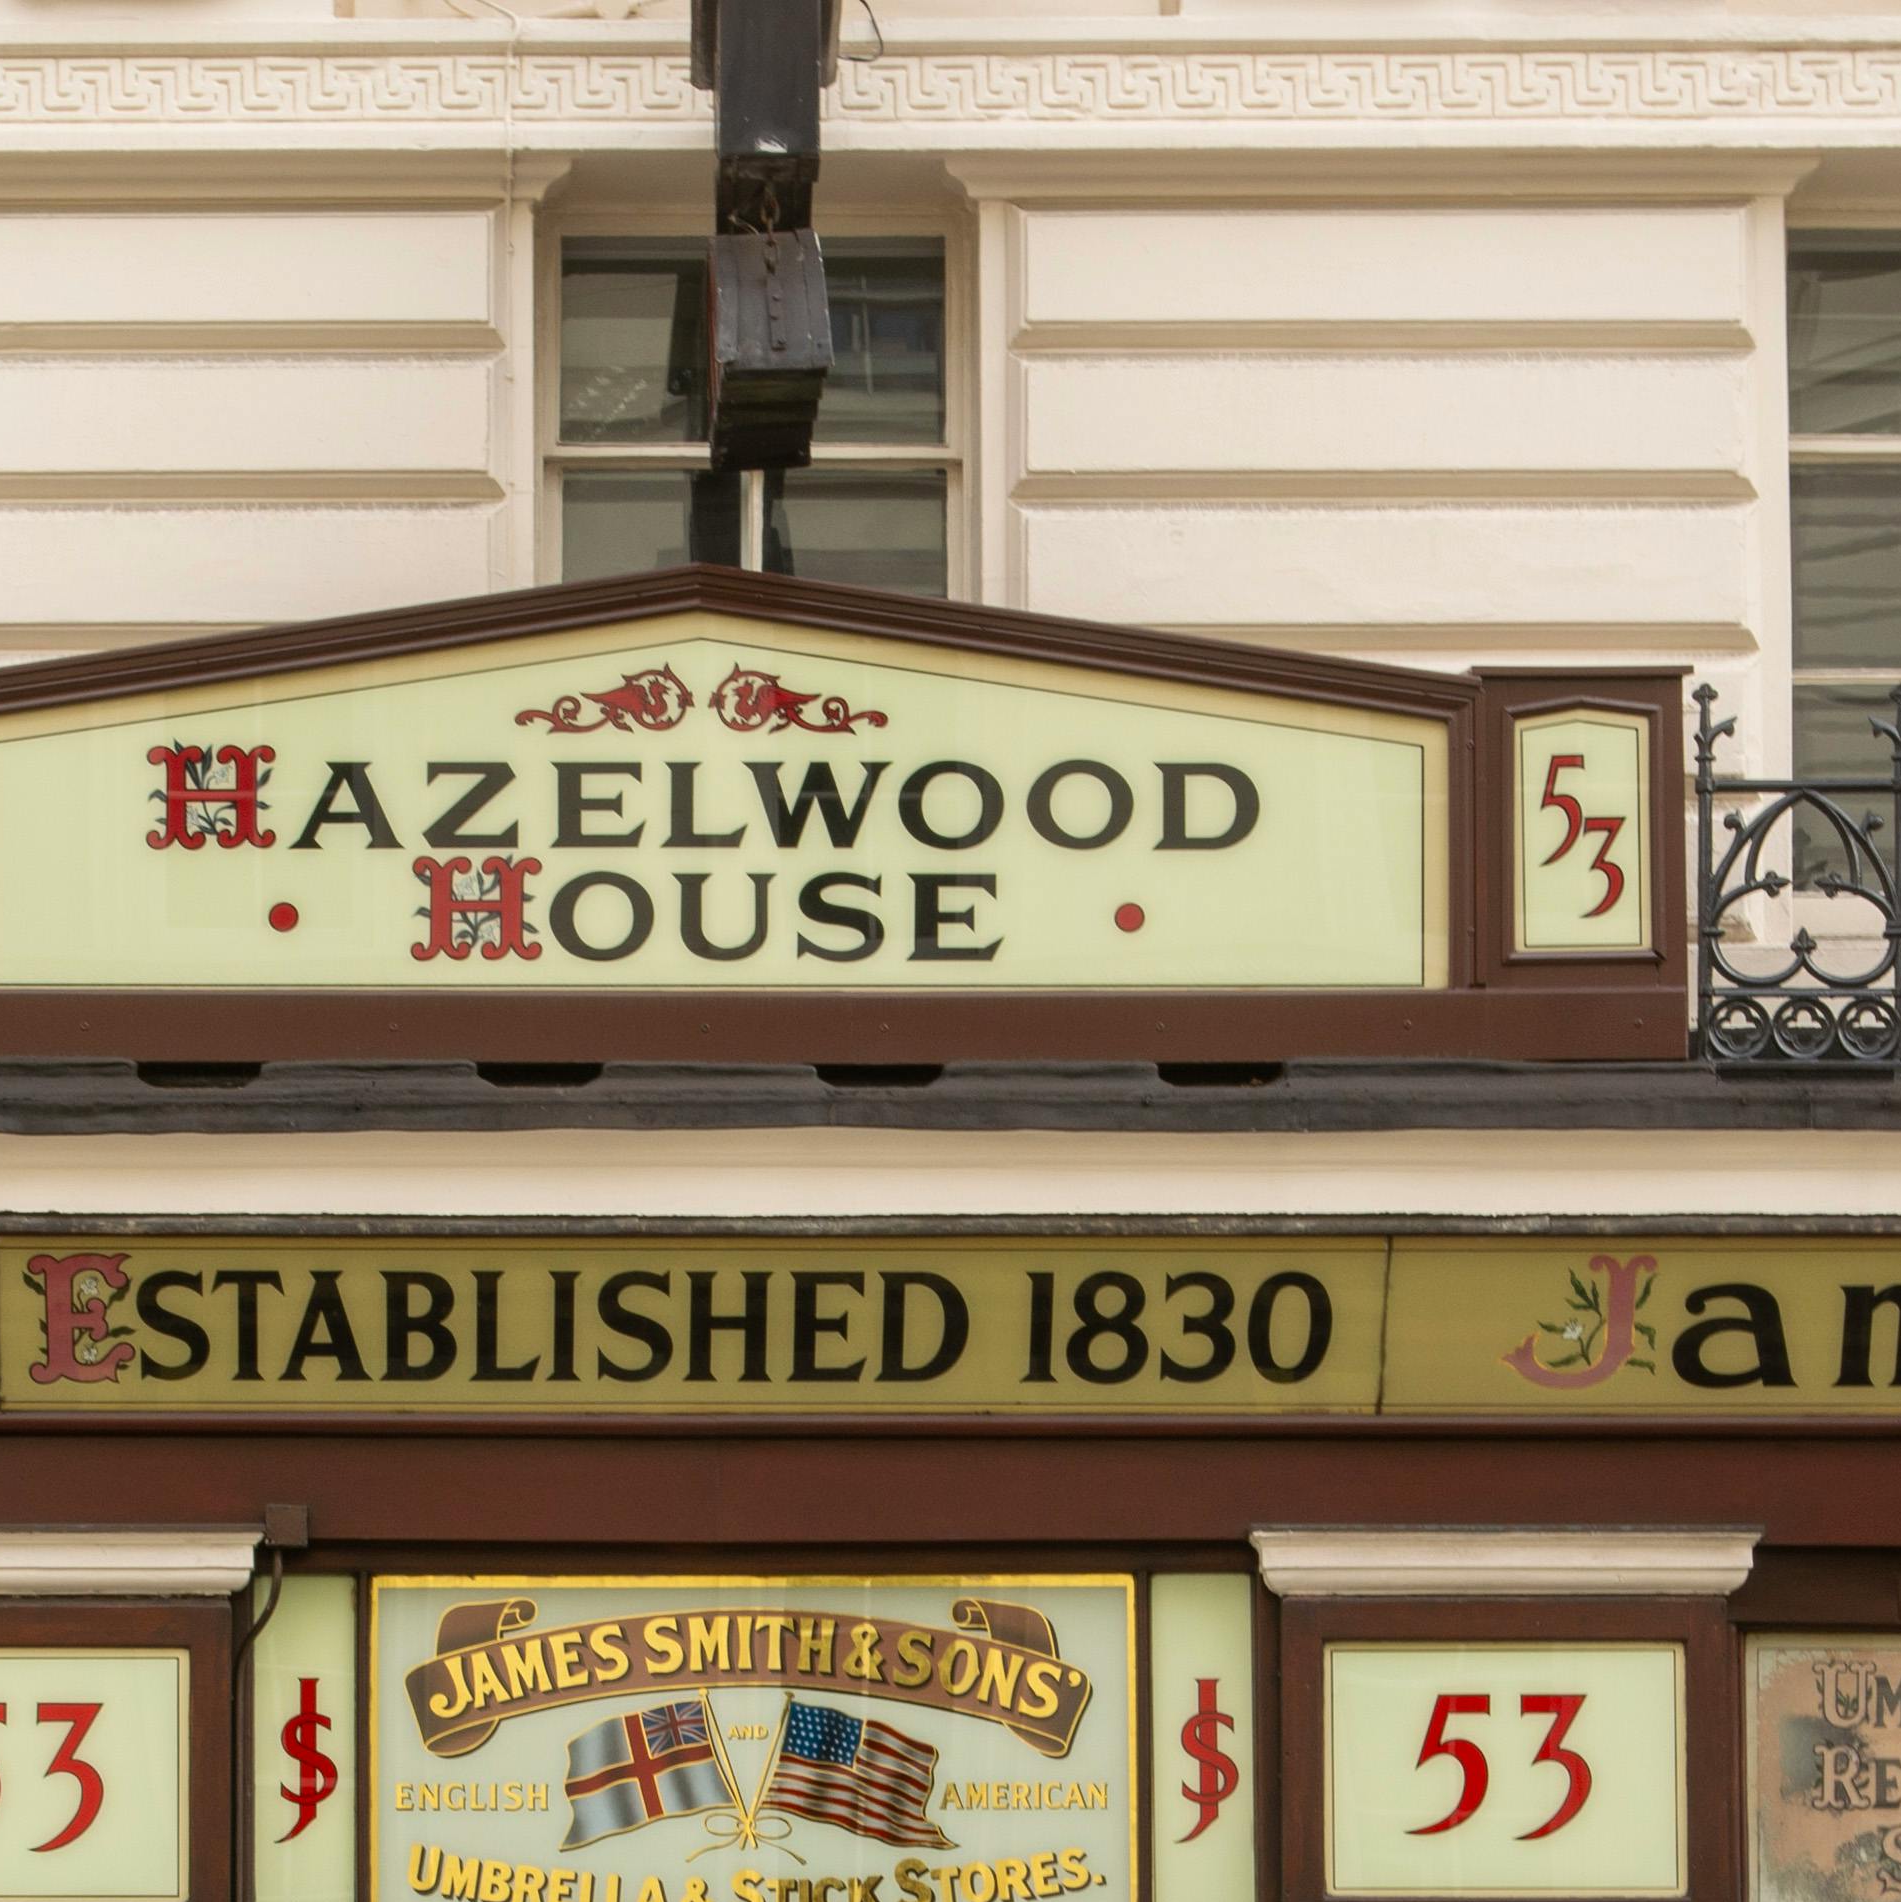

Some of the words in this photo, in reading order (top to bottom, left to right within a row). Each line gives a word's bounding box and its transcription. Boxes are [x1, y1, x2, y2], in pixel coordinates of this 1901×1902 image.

[145, 740, 1261, 853] HAZELWOOD
[1538, 753, 1627, 922] 53
[410, 855, 1004, 965] HOUSE
[24, 1253, 969, 1386] ESTABLISHED
[1032, 1270, 1330, 1381] 1830
[429, 1622, 634, 1720] JAMES
[643, 1615, 836, 1677] SMITH
[842, 1622, 885, 1678] &
[728, 1724, 768, 1740] AND
[1406, 1694, 1592, 1840] 53
[395, 1782, 549, 1811] ENGLISH
[940, 1781, 1107, 1810] AMERICAN
